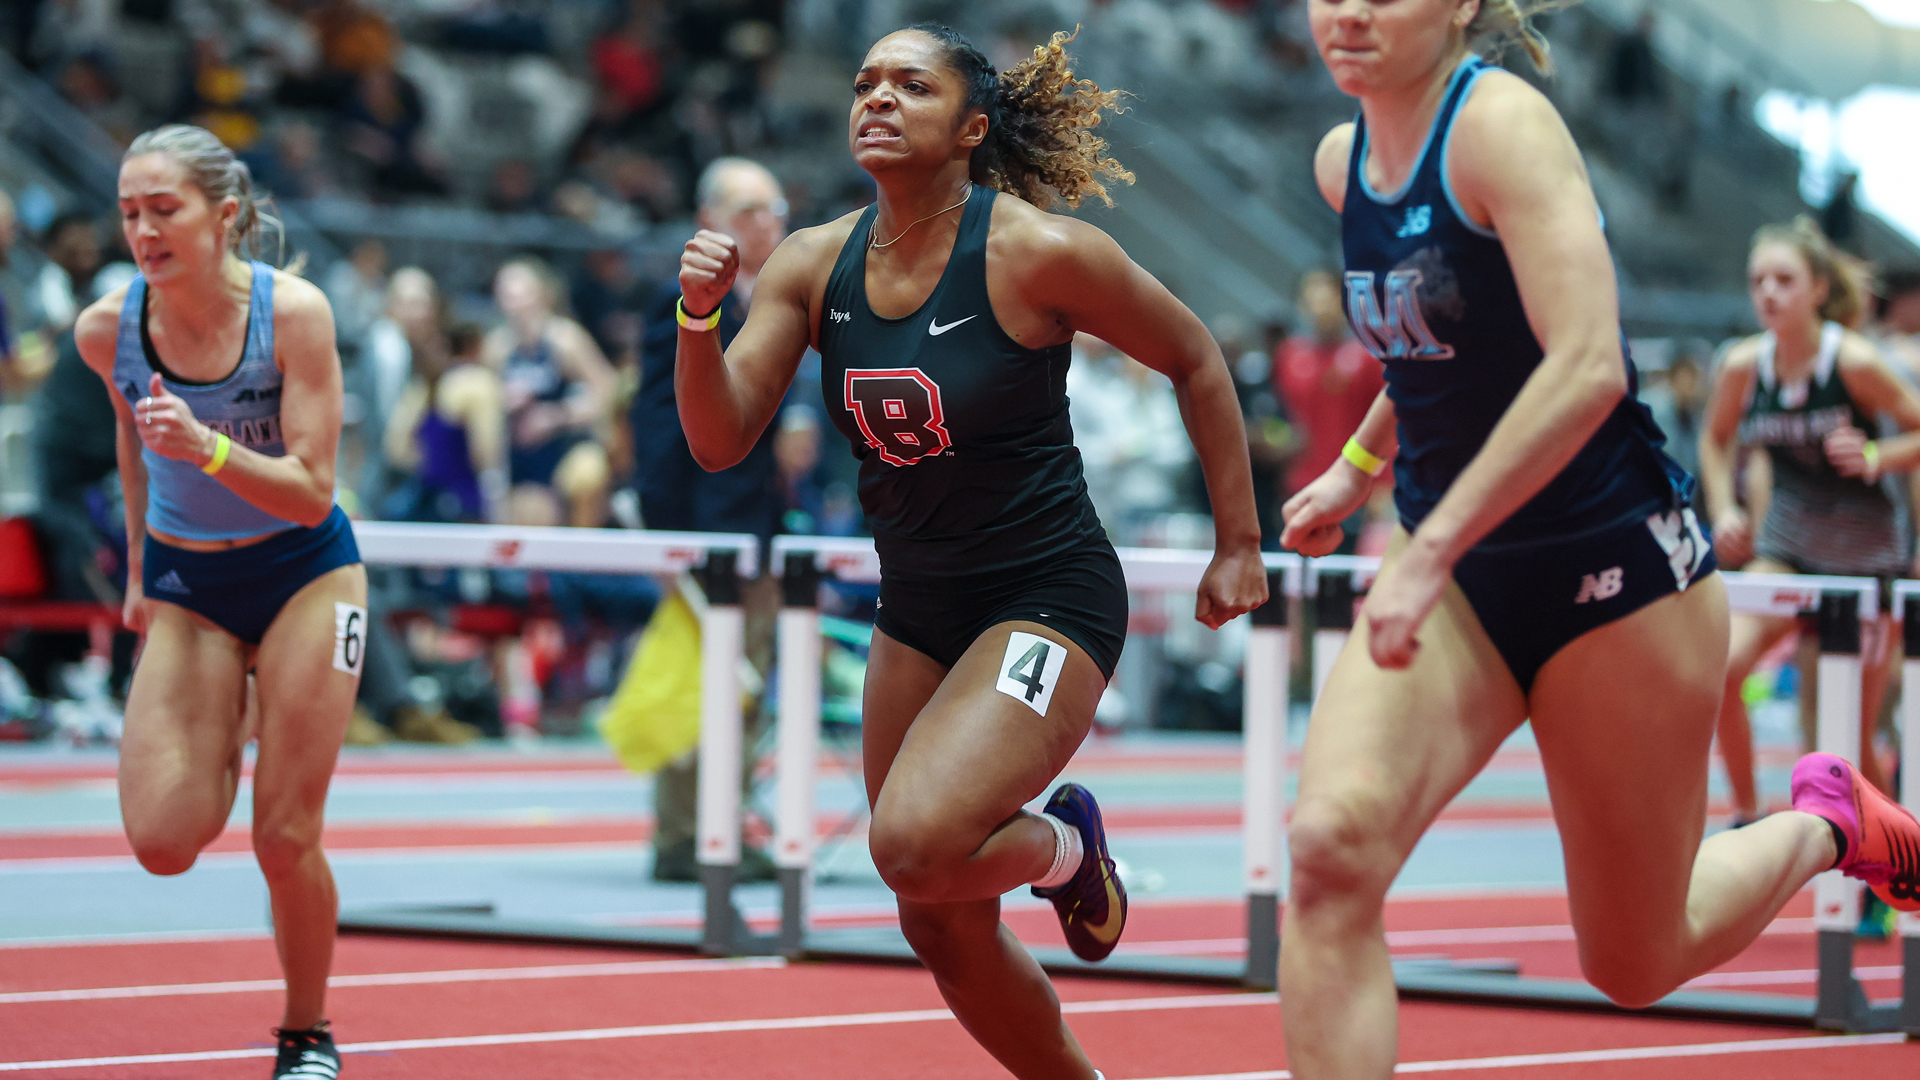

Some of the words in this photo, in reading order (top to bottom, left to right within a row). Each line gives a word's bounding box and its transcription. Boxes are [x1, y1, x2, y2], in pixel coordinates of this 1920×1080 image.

[830, 308, 845, 324] Ivy
[1344, 268, 1455, 361] M
[844, 367, 953, 467] B
[1574, 566, 1624, 604] NB
[345, 611, 360, 669] 6
[1007, 640, 1051, 704] 4
